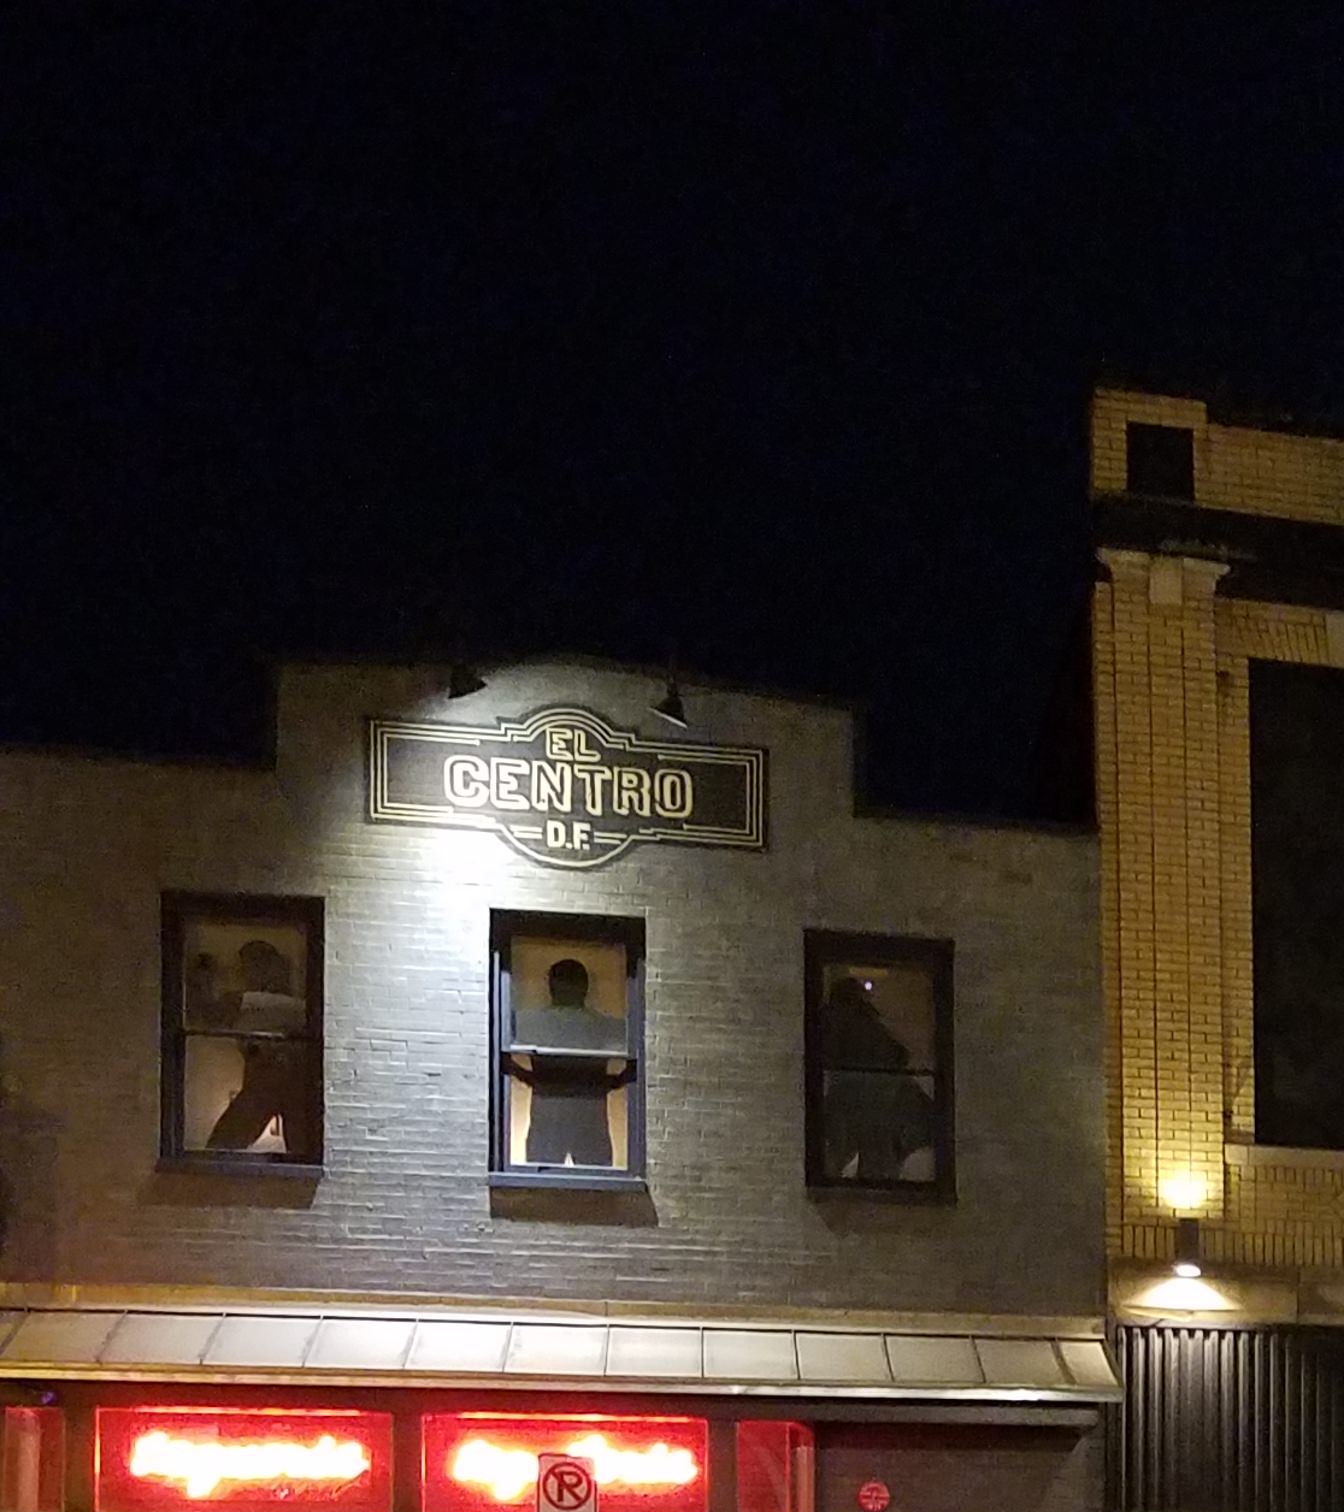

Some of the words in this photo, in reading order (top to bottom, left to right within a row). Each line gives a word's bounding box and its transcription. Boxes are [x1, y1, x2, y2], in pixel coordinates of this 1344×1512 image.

[545, 728, 601, 761] EL
[443, 754, 693, 819] CENTRO
[546, 820, 592, 851] D.F.
